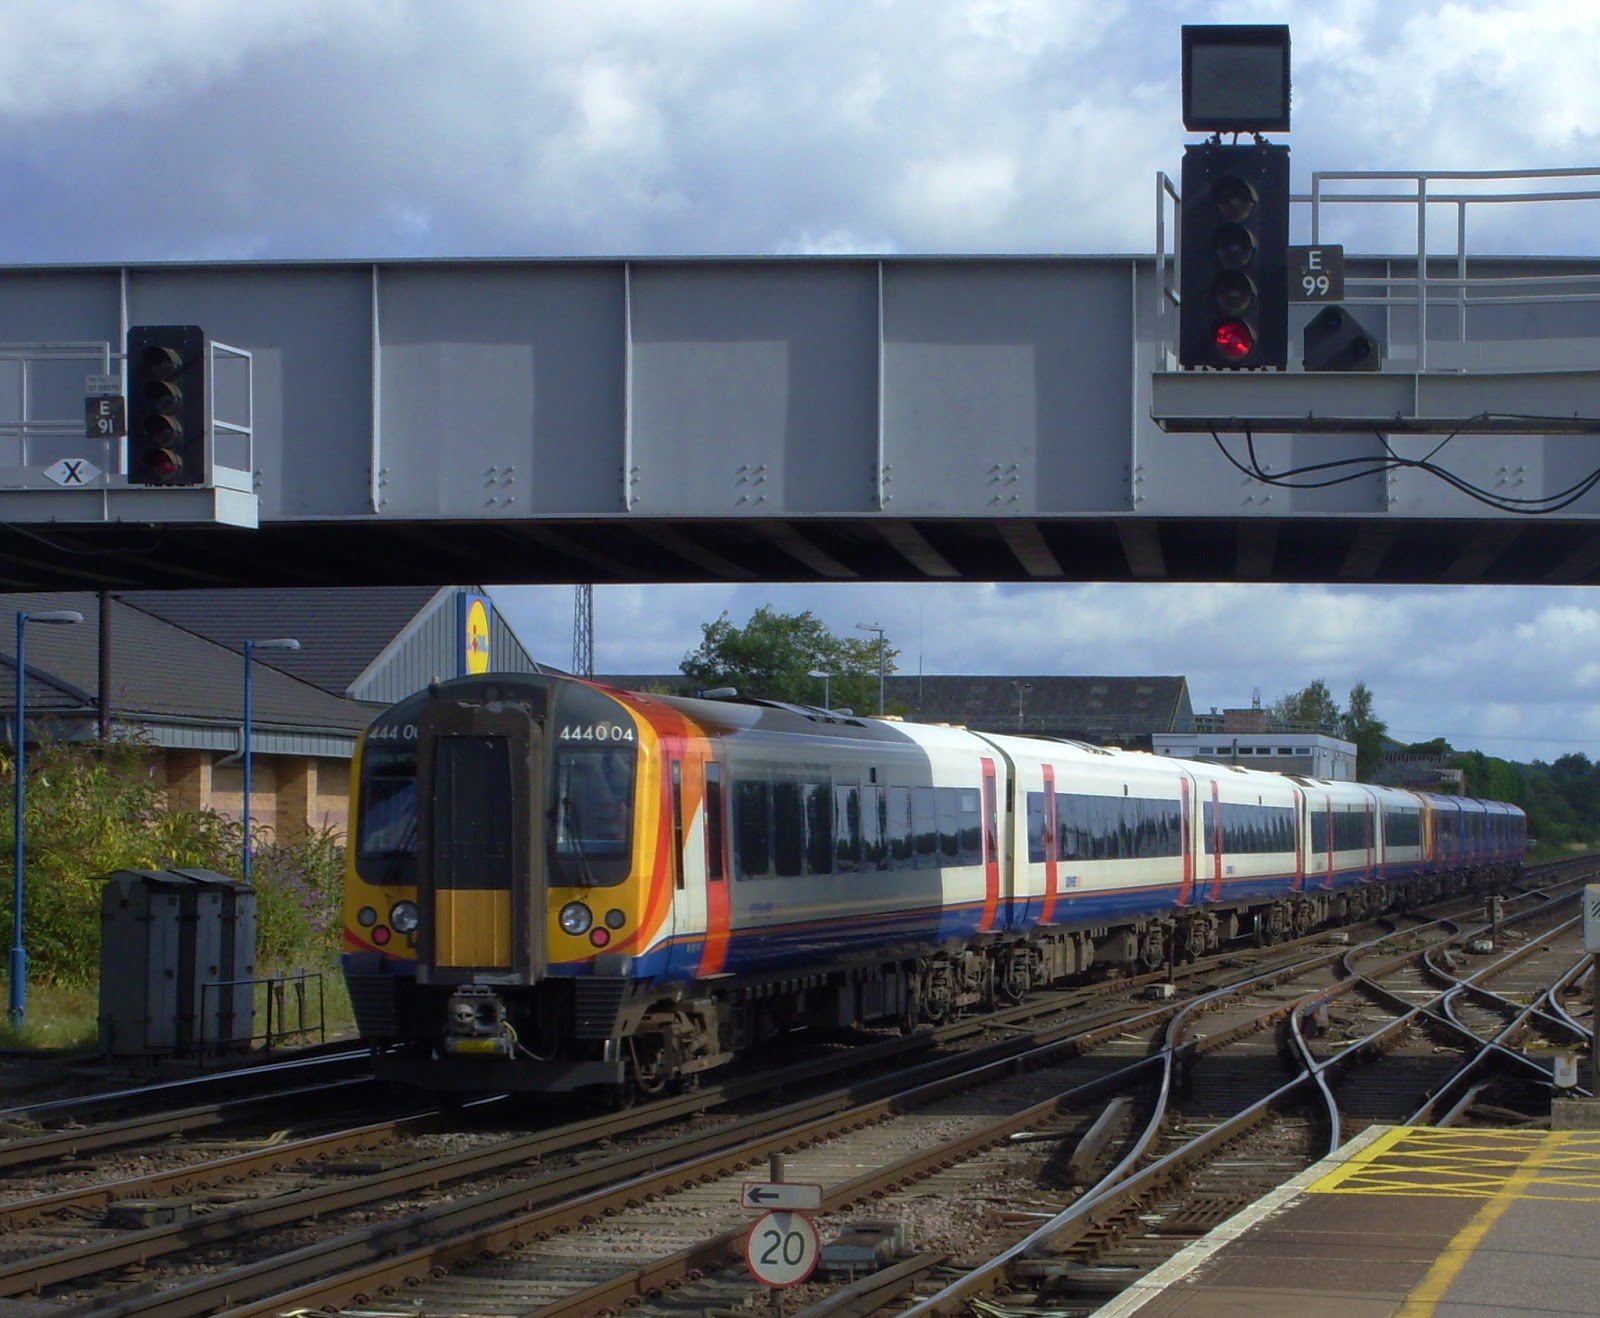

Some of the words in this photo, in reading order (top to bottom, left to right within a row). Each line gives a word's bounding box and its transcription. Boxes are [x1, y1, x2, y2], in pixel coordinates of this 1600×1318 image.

[1309, 250, 1322, 270] E
[1302, 275, 1330, 296] 99
[99, 400, 110, 416] E
[97, 419, 114, 434] 91
[62, 461, 83, 484] X
[559, 724, 635, 742] 444004
[760, 1229, 806, 1266] 20
